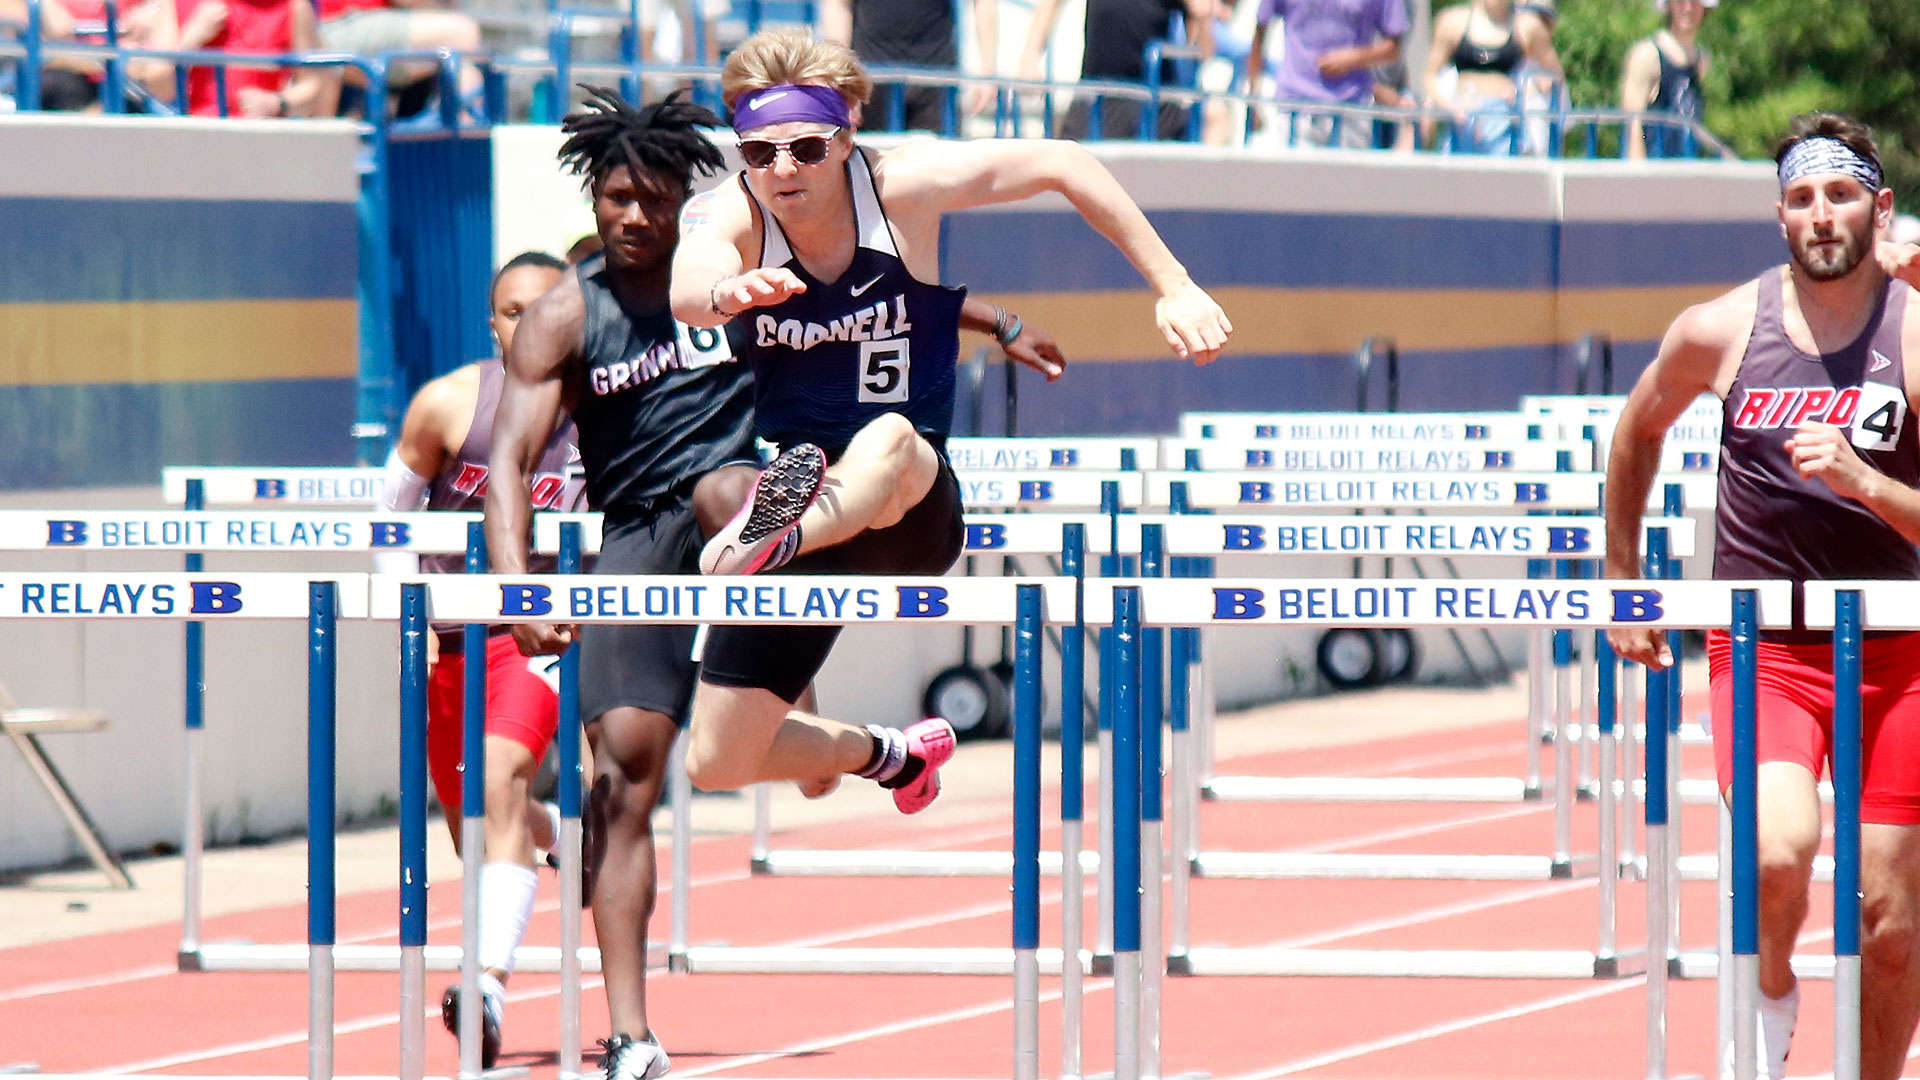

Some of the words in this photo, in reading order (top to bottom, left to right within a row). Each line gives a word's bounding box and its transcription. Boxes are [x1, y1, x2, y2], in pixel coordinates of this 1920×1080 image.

[689, 326, 721, 353] 6
[590, 341, 682, 396] GRINN
[865, 350, 901, 394] 5
[1734, 387, 1861, 429] RIPO
[1862, 400, 1897, 442] 4
[1371, 424, 1453, 440] RELAYS
[949, 449, 1039, 468] RELAYS
[1285, 450, 1363, 470] BELOIT
[1378, 451, 1470, 470] RELAYS
[1019, 481, 1054, 501] B
[1239, 482, 1273, 502] B
[1285, 481, 1379, 502] BELOIT
[1392, 482, 1499, 501] RELAYS
[1515, 482, 1549, 503] B
[47, 520, 88, 546] B
[102, 521, 211, 547] BELOIT
[227, 521, 351, 546] RELAYS
[370, 522, 412, 547] B
[966, 524, 1006, 549] B
[1223, 525, 1266, 550] B
[1279, 526, 1391, 550] BELOIT
[1406, 526, 1532, 551] RELAYS
[1548, 527, 1591, 552] B
[22, 583, 175, 614] RELAYS
[189, 581, 243, 614] B
[500, 584, 552, 616] B
[570, 586, 707, 616] BELOIT
[726, 587, 879, 618] RELAYS
[896, 586, 949, 618] B
[1212, 588, 1265, 620] B
[1280, 588, 1416, 619] BELOIT
[1435, 588, 1590, 620] RELAYS
[1611, 589, 1664, 622] B
